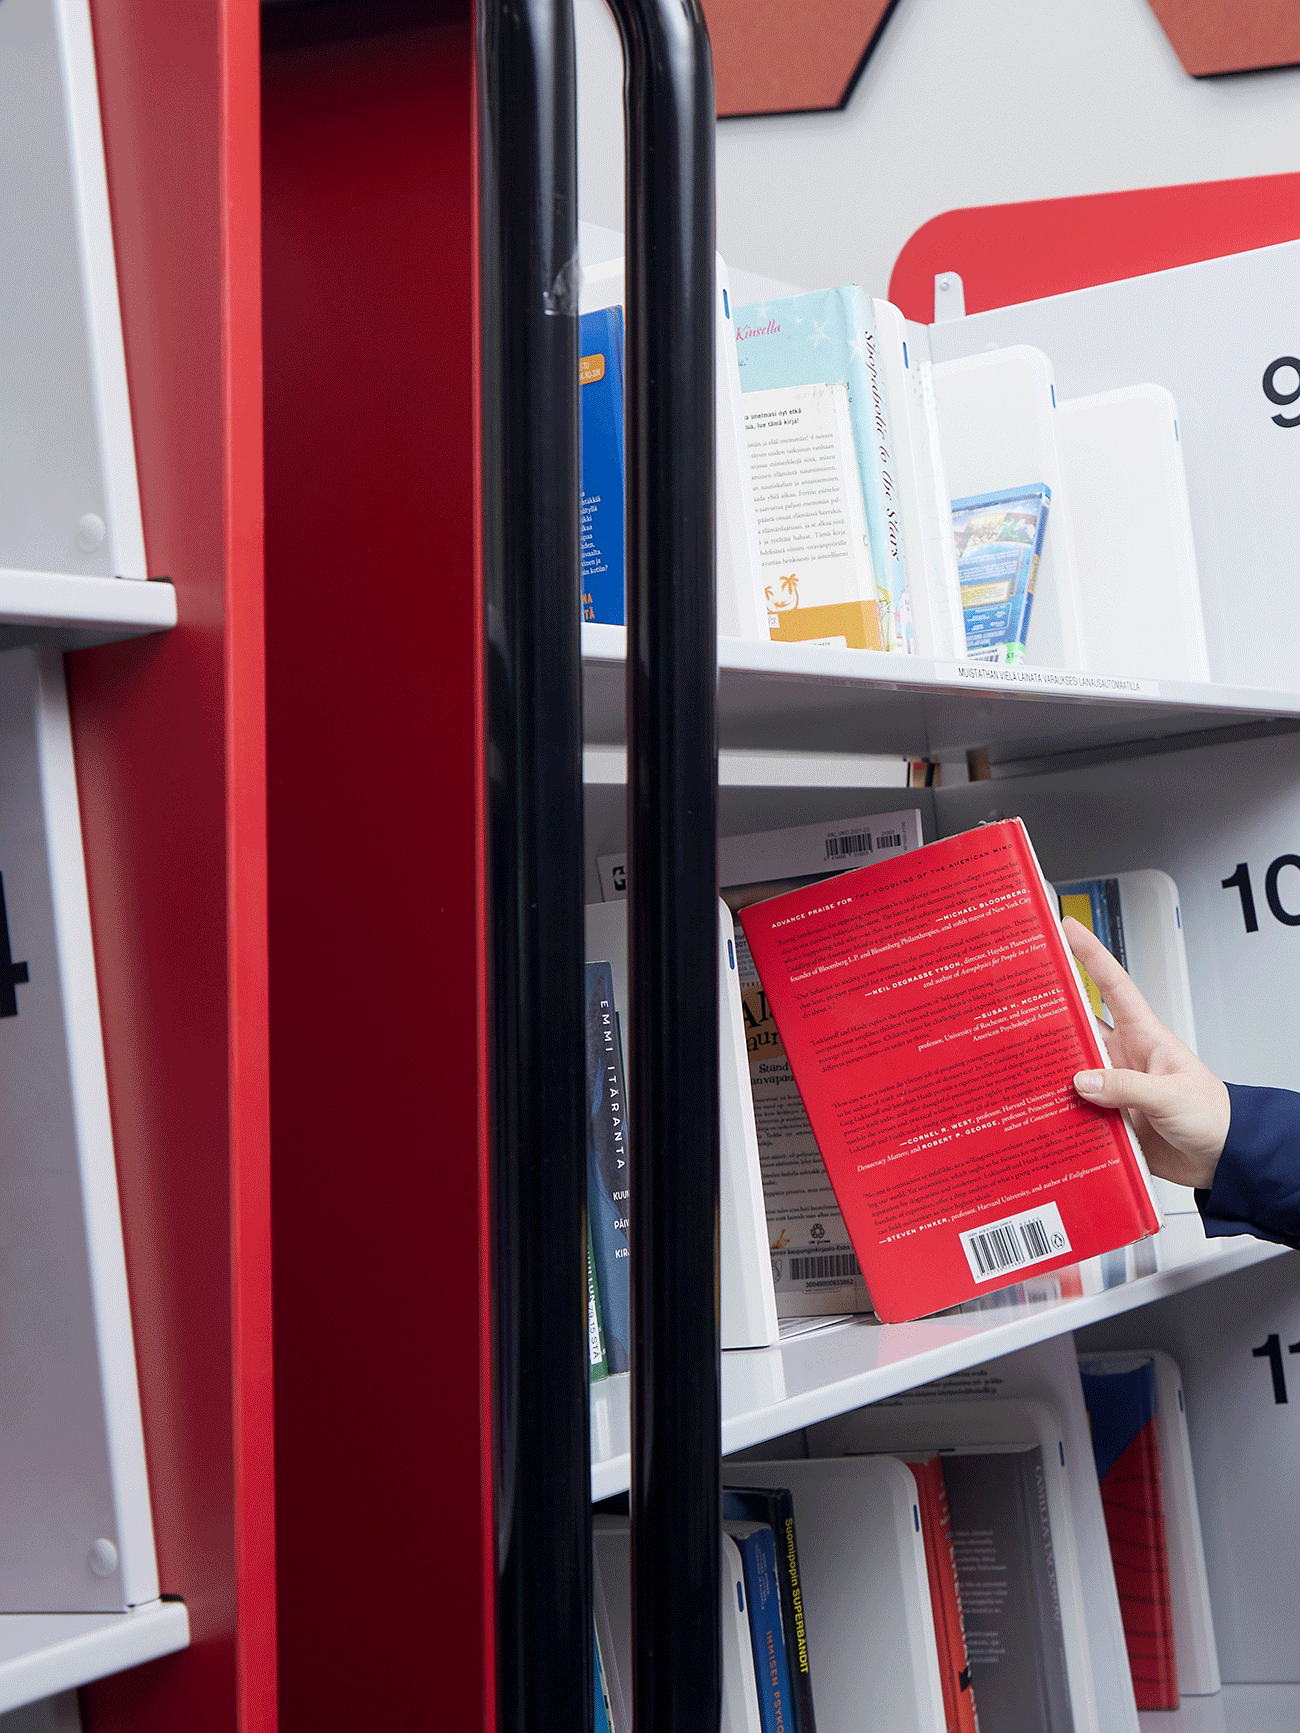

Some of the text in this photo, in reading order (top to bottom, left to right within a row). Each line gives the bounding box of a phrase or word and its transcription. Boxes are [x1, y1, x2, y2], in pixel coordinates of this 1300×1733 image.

[736, 319, 781, 341] Kinsella
[864, 330, 899, 561] Shopaholic to the Stars
[958, 668, 998, 679] MUISTATHAN
[1017, 673, 1042, 682] LAINATA
[1043, 675, 1078, 686] VARAUKSESI
[1079, 678, 1140, 691] LAINAUSAUTOMAATILLA
[772, 844, 1012, 928] ADVANCE PRAISE FOR THE CODDLING OF THE AMERICAN MIND
[936, 889, 1029, 922] —MICHAEL BLOOMBERG,
[790, 972, 811, 982] founder
[812, 967, 818, 975] of
[818, 960, 848, 972] Bloomberg
[848, 954, 860, 963] L.P.
[860, 950, 871, 959] and
[871, 942, 901, 955] Bloomberg
[900, 929, 940, 944] Philanthropies,
[941, 923, 952, 931] and
[952, 918, 968, 927] 108th
[968, 913, 985, 922] mayor
[1005, 901, 1019, 909] York
[1019, 897, 1031, 905] City
[865, 934, 1045, 996] —NEIL DEGRASSE TYSON, director, Hayden Planetarium,
[923, 979, 934, 988] and
[935, 975, 953, 984] author
[953, 970, 960, 978] of
[961, 962, 991, 975] Astrophysics
[992, 958, 1000, 966] for
[1000, 952, 1017, 962] People
[1030, 943, 1047, 952] Hurry
[918, 997, 1066, 1052] professor, University of Rochester, and former president,
[973, 1006, 1068, 1041] American Psychological Association
[974, 1006, 1008, 1020] —SUSAN
[1021, 988, 1063, 1004] MCDANIEL,
[600, 1000, 625, 1170] EMMI ITÄRANTA
[900, 1131, 938, 1146] —CORNEL
[951, 1119, 975, 1129] WEST,
[976, 1110, 1002, 1123] professor,
[1002, 1099, 1026, 1112] Harvard
[1026, 1091, 1056, 1104] University,
[1057, 1085, 1067, 1094] and
[857, 1159, 886, 1172] Democracy
[910, 1145, 921, 1154] and
[922, 1135, 952, 1149] ROBERT
[965, 1120, 1000, 1134] GEORGE,
[1001, 1111, 1027, 1124] professor,
[1028, 1102, 1054, 1113] Princeton
[1004, 1122, 1022, 1132] author
[1030, 1110, 1057, 1123] Conscience
[1059, 1104, 1069, 1113] and
[879, 1158, 1120, 1244] —STEVEN PINKER, professor, Harvard University, and author of Enlightenment New
[615, 1248, 630, 1259] KIR
[785, 1518, 809, 1673] Suomipopin SUPERBANDIT
[766, 1631, 785, 1733] IHMISEN PSYKO
